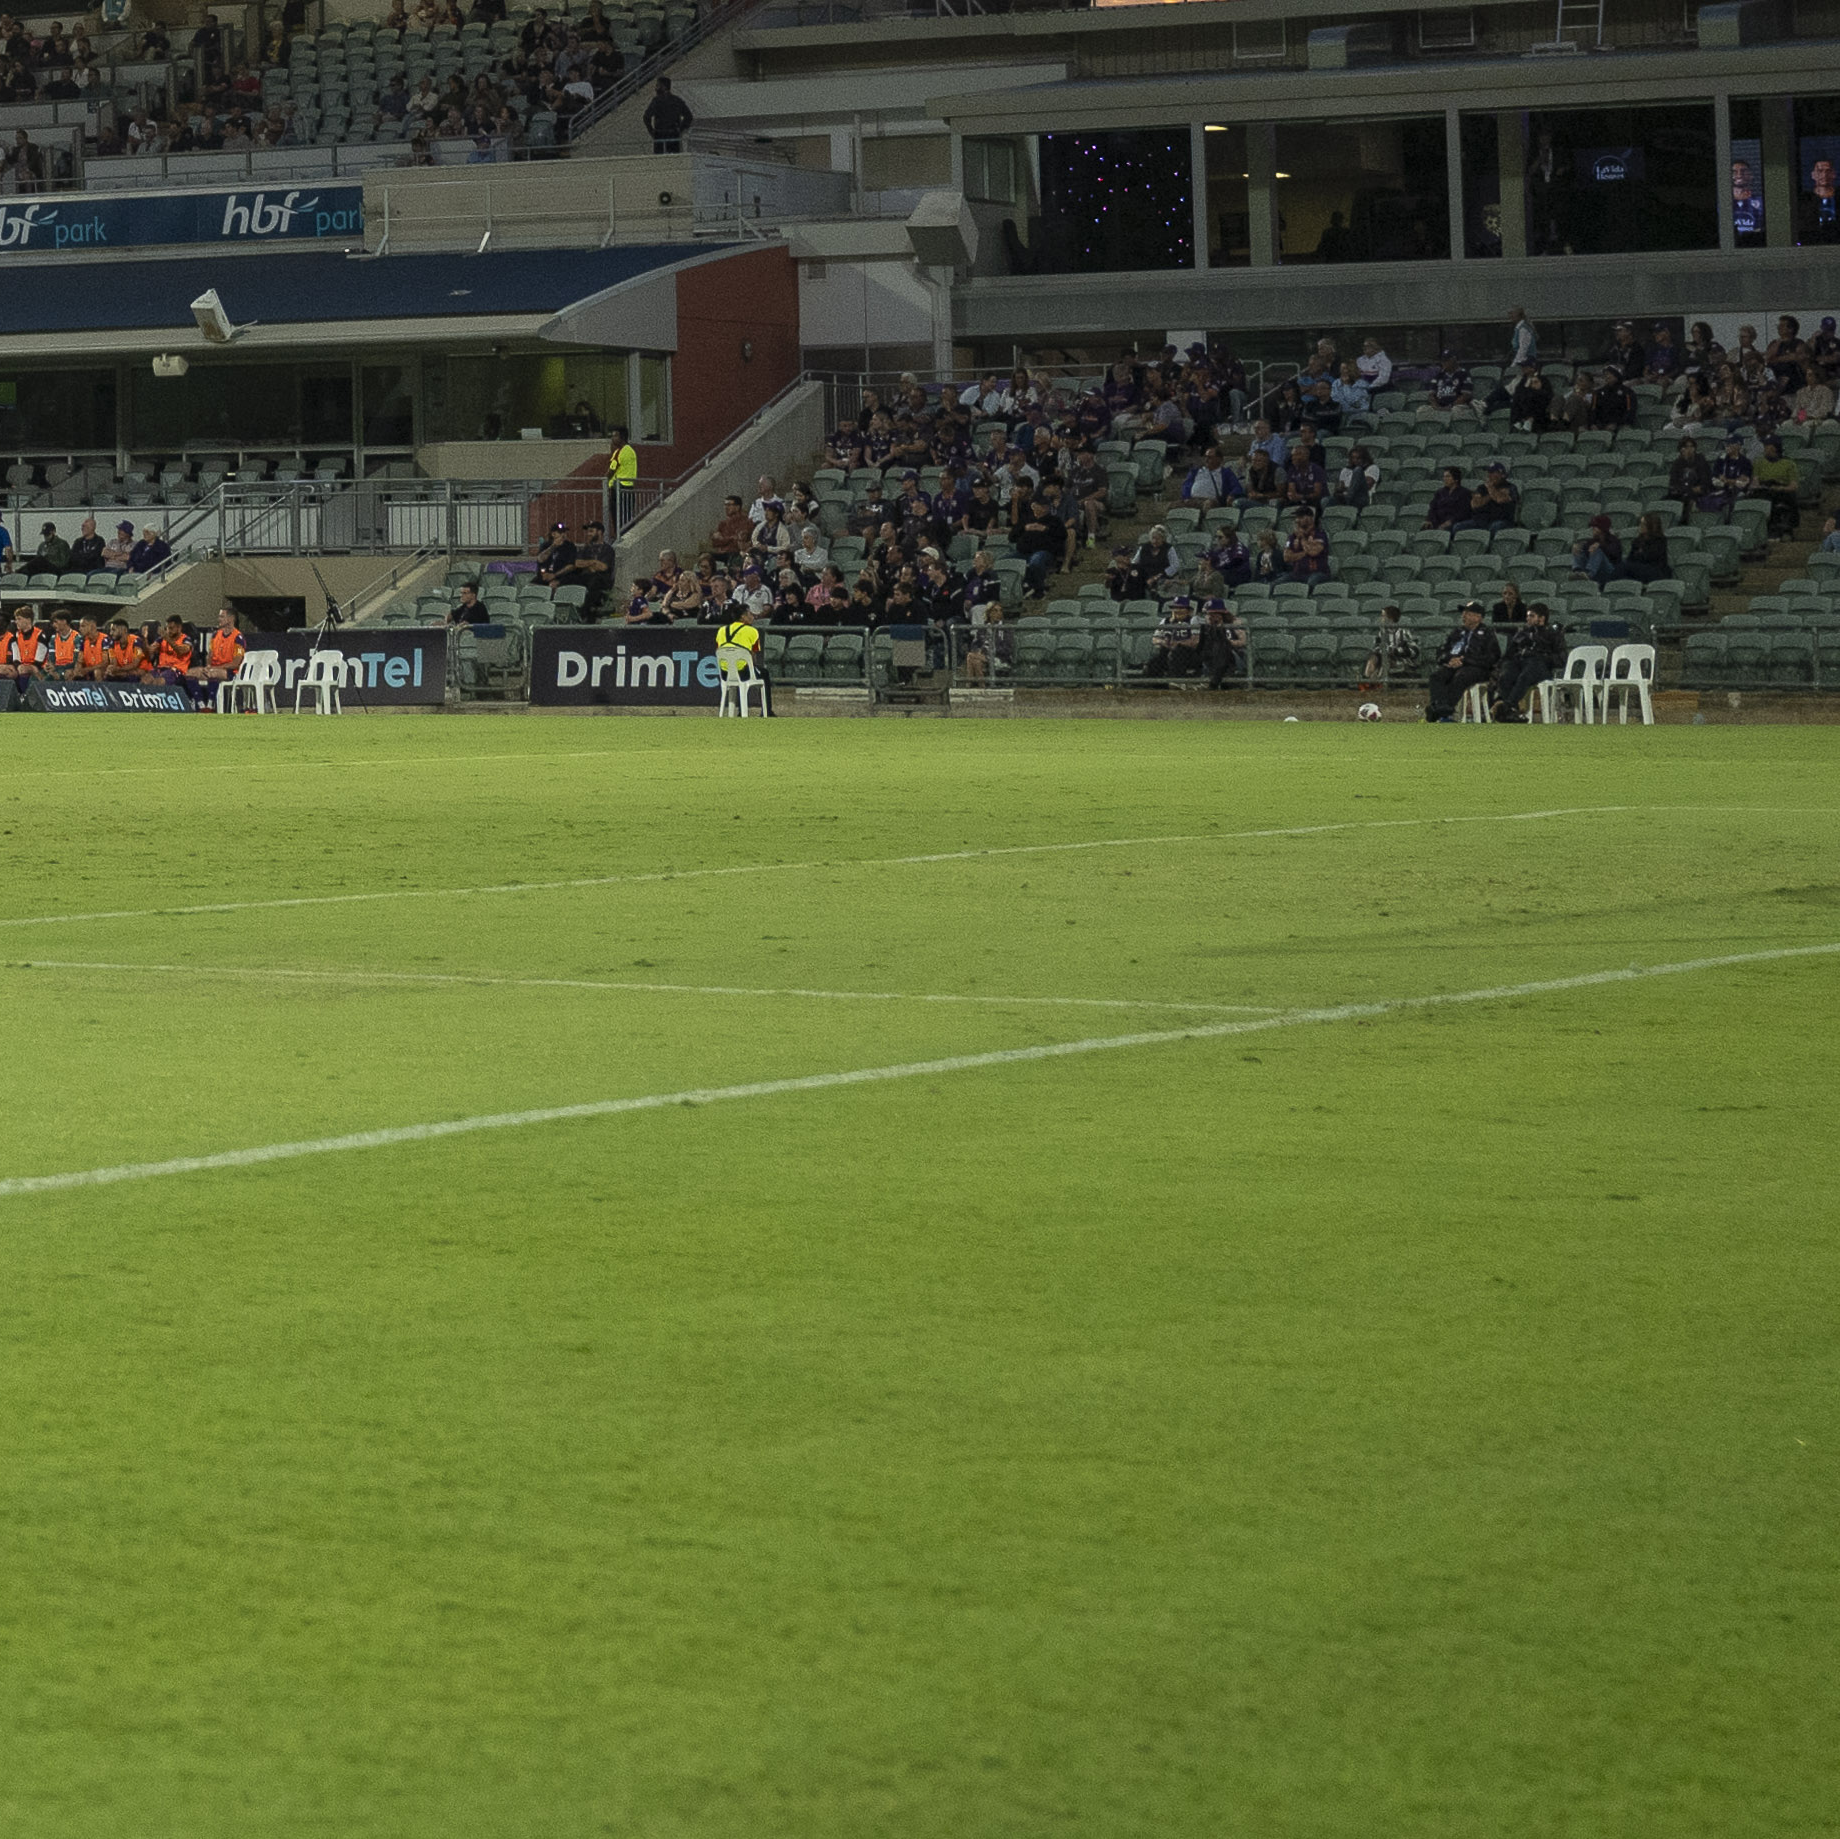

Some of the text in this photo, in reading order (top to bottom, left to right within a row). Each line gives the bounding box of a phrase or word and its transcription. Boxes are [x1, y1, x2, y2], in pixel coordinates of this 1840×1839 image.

[221, 191, 300, 234] hbf
[55, 216, 107, 248] park
[557, 646, 720, 687] DrimTe
[46, 684, 185, 710] DrimTel DrimTel
